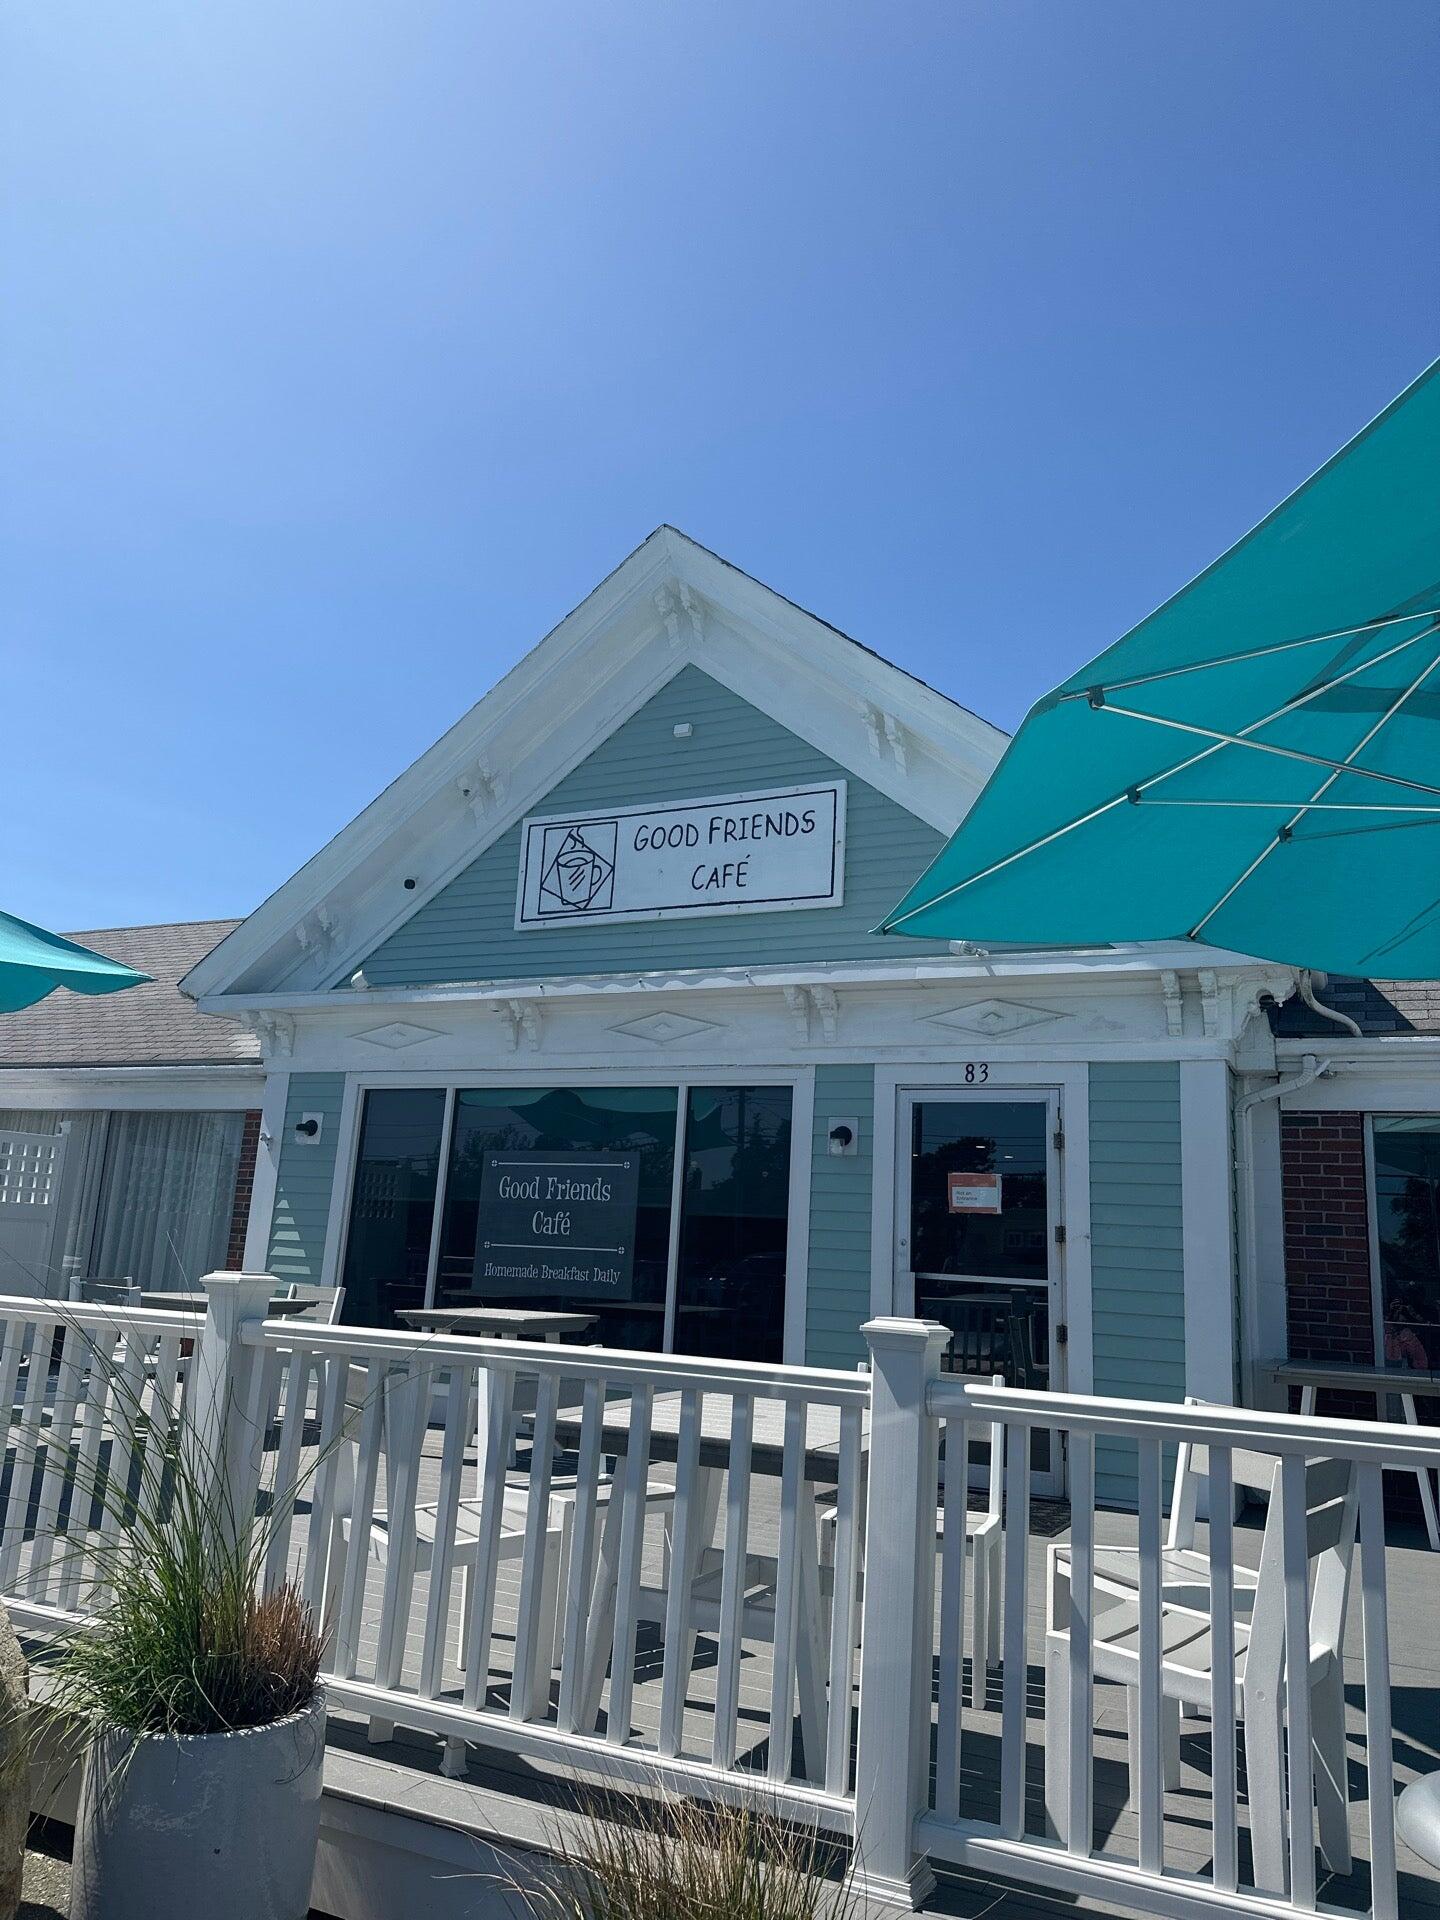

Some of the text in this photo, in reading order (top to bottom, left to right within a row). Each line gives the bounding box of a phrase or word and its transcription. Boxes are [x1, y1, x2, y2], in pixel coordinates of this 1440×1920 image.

[633, 810, 816, 851] GOOD FRIENDS
[691, 854, 751, 890] CAFÉ
[965, 1063, 988, 1083] 83
[499, 1176, 611, 1202] Good Friends
[532, 1210, 571, 1235] Café
[484, 1262, 621, 1285] Homemade Breakfast Daily
